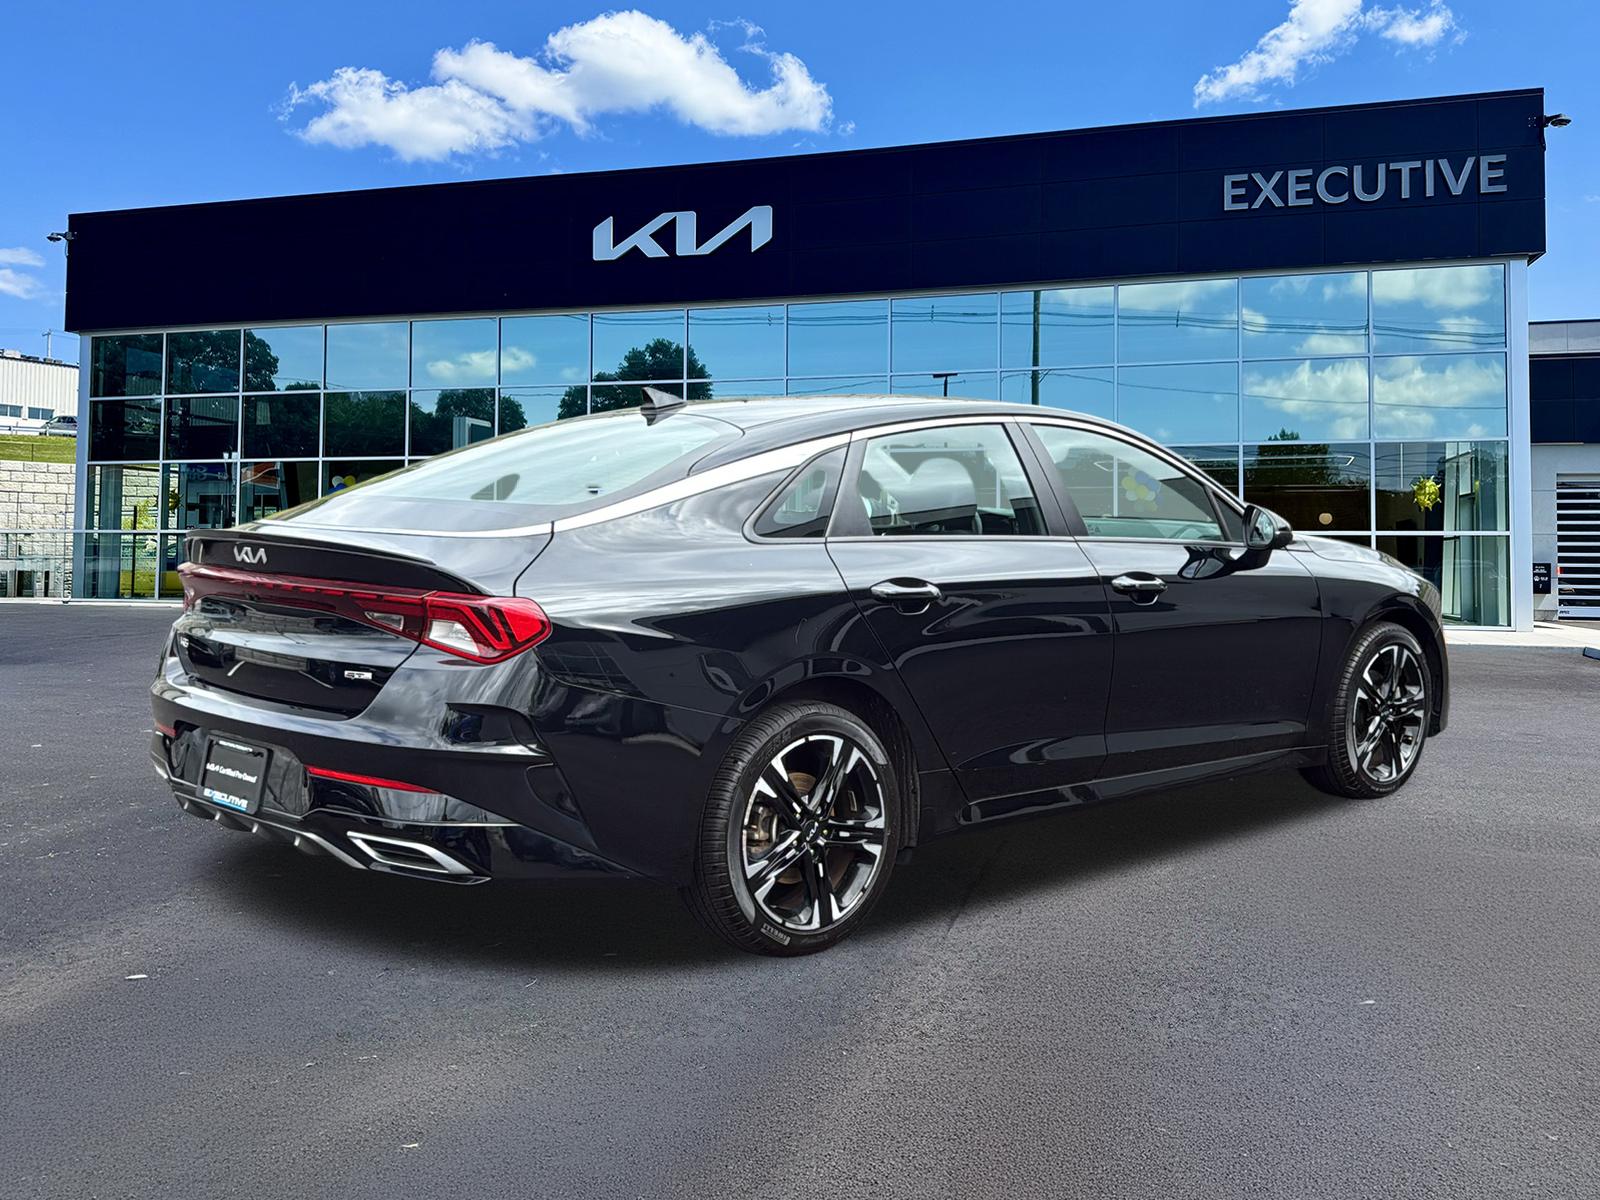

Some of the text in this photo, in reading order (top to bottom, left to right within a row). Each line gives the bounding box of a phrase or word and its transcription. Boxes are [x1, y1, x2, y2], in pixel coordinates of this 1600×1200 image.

[1223, 154, 1508, 211] EXECUTIVE
[593, 205, 773, 261] KIA
[233, 545, 267, 565] KIA
[203, 787, 248, 809] EXECUTIVE
